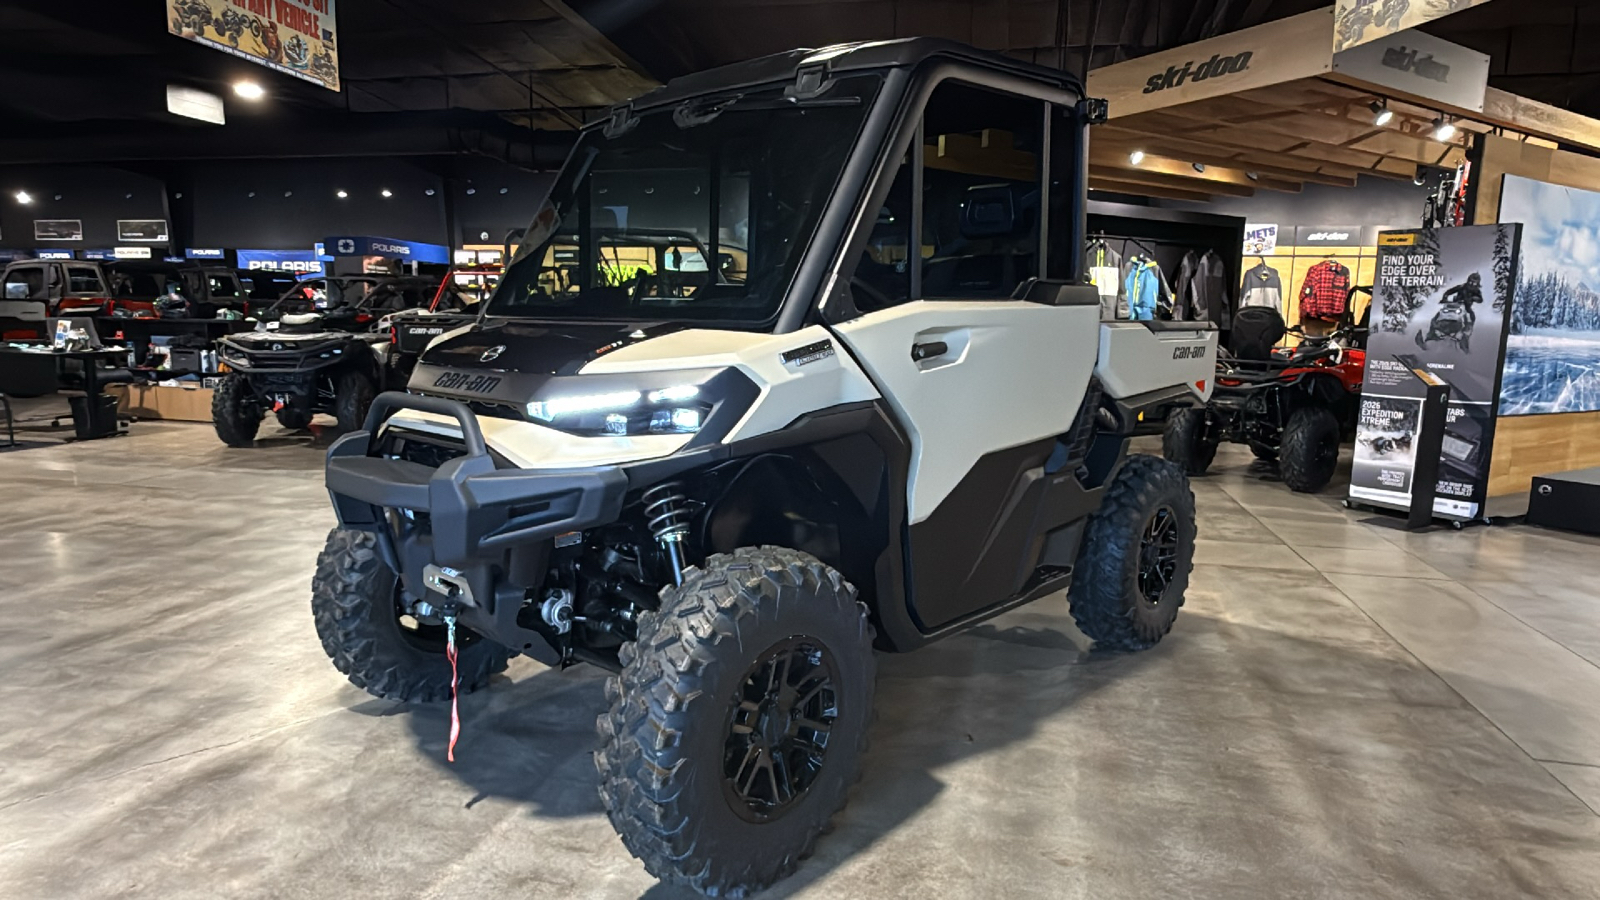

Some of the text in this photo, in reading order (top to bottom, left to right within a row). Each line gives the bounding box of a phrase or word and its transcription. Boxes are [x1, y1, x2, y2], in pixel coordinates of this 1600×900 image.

[274, 0, 320, 40] VEHICLE
[1142, 51, 1254, 94] ski-doo
[1244, 226, 1276, 241] METS
[372, 242, 411, 255] POLARIS
[1382, 254, 1434, 266] FIND YOUR
[249, 260, 322, 273] POLARIS
[1381, 265, 1436, 276] EDGE OVER
[1380, 276, 1400, 286] THE
[409, 327, 443, 335] can-am
[1172, 345, 1206, 360] can-am
[433, 371, 502, 394] can-am
[1362, 400, 1380, 410] 2026
[1361, 408, 1404, 420] EXPEDITION
[1446, 407, 1466, 416] TABS
[1360, 415, 1391, 426] XTREME
